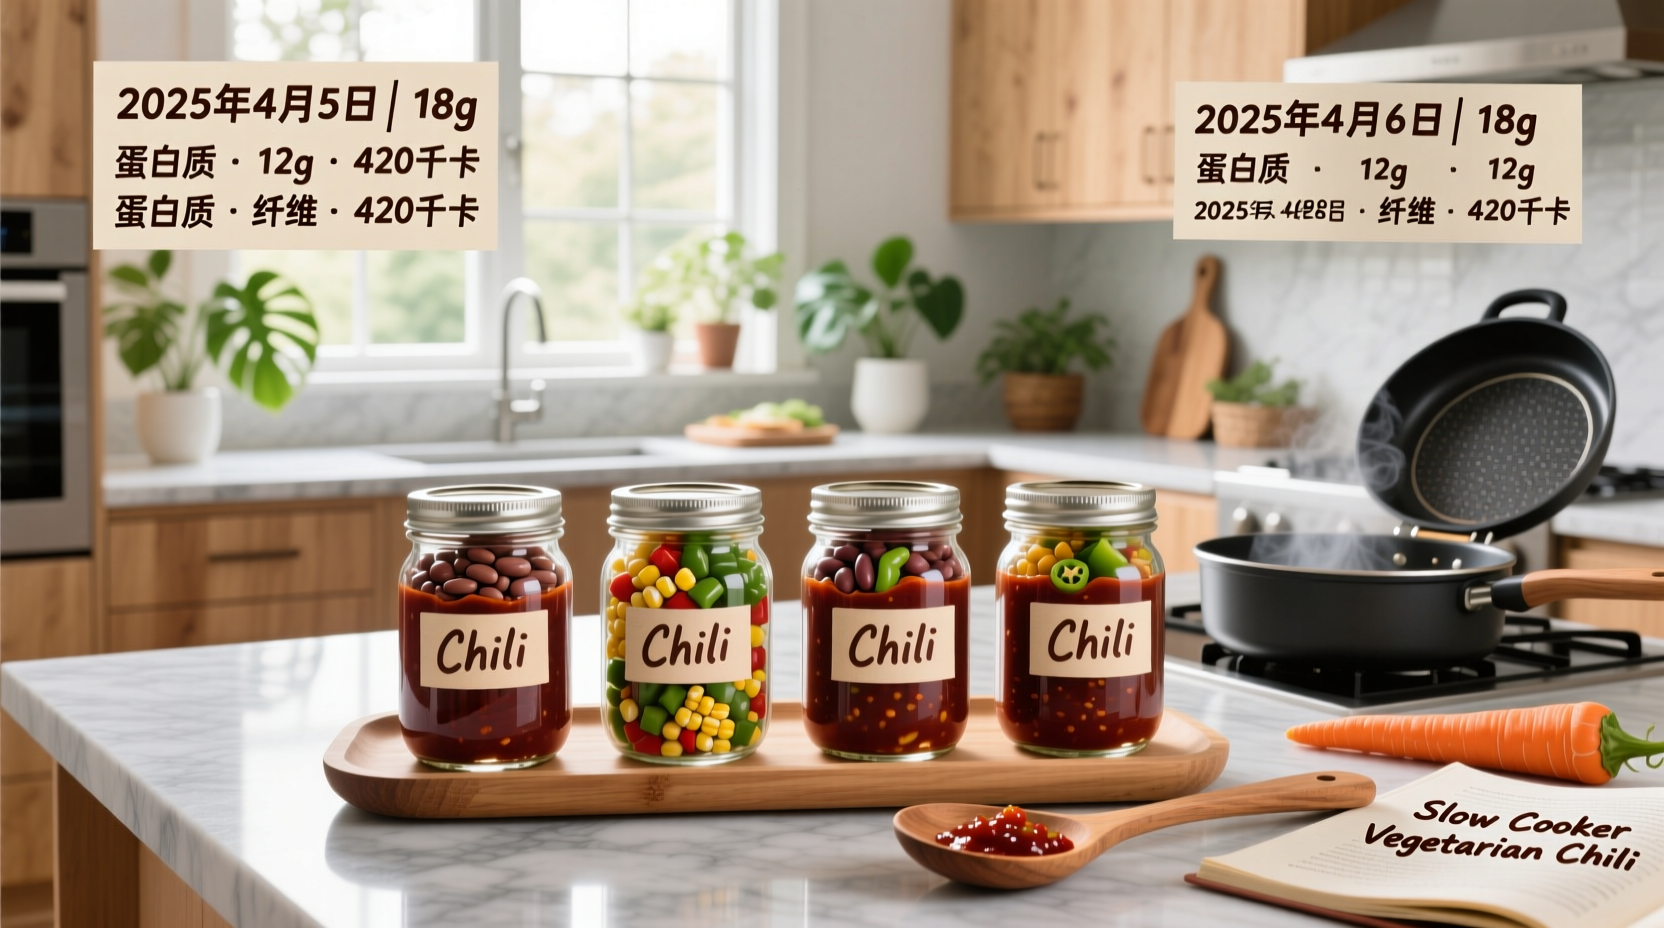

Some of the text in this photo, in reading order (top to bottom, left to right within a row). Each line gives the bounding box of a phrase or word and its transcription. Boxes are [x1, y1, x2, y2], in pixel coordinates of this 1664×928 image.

[117, 84, 376, 123] 2025年4月5日
[414, 87, 478, 131] 18g
[1194, 100, 1442, 137] 2025年4月6日
[1478, 104, 1537, 146] 18g
[115, 144, 217, 180] 蛋白质
[259, 147, 314, 185] 12g
[353, 144, 480, 179] 420千卡
[1197, 152, 1290, 185] 蛋白质
[1361, 157, 1408, 190] 12g
[1488, 157, 1535, 190] 12g
[115, 194, 215, 228] 蛋白质
[252, 194, 318, 227] 纤维
[354, 194, 479, 227] 420千卡
[1377, 196, 1436, 225] 纤维
[1468, 196, 1570, 226] 420千卡
[437, 628, 528, 675] Chili
[642, 623, 731, 668] Chili
[848, 623, 937, 668] Chili
[1047, 618, 1135, 663] Chili
[1413, 800, 1632, 840] Slow Cooker
[1364, 822, 1641, 872] Vegetarian Chili
